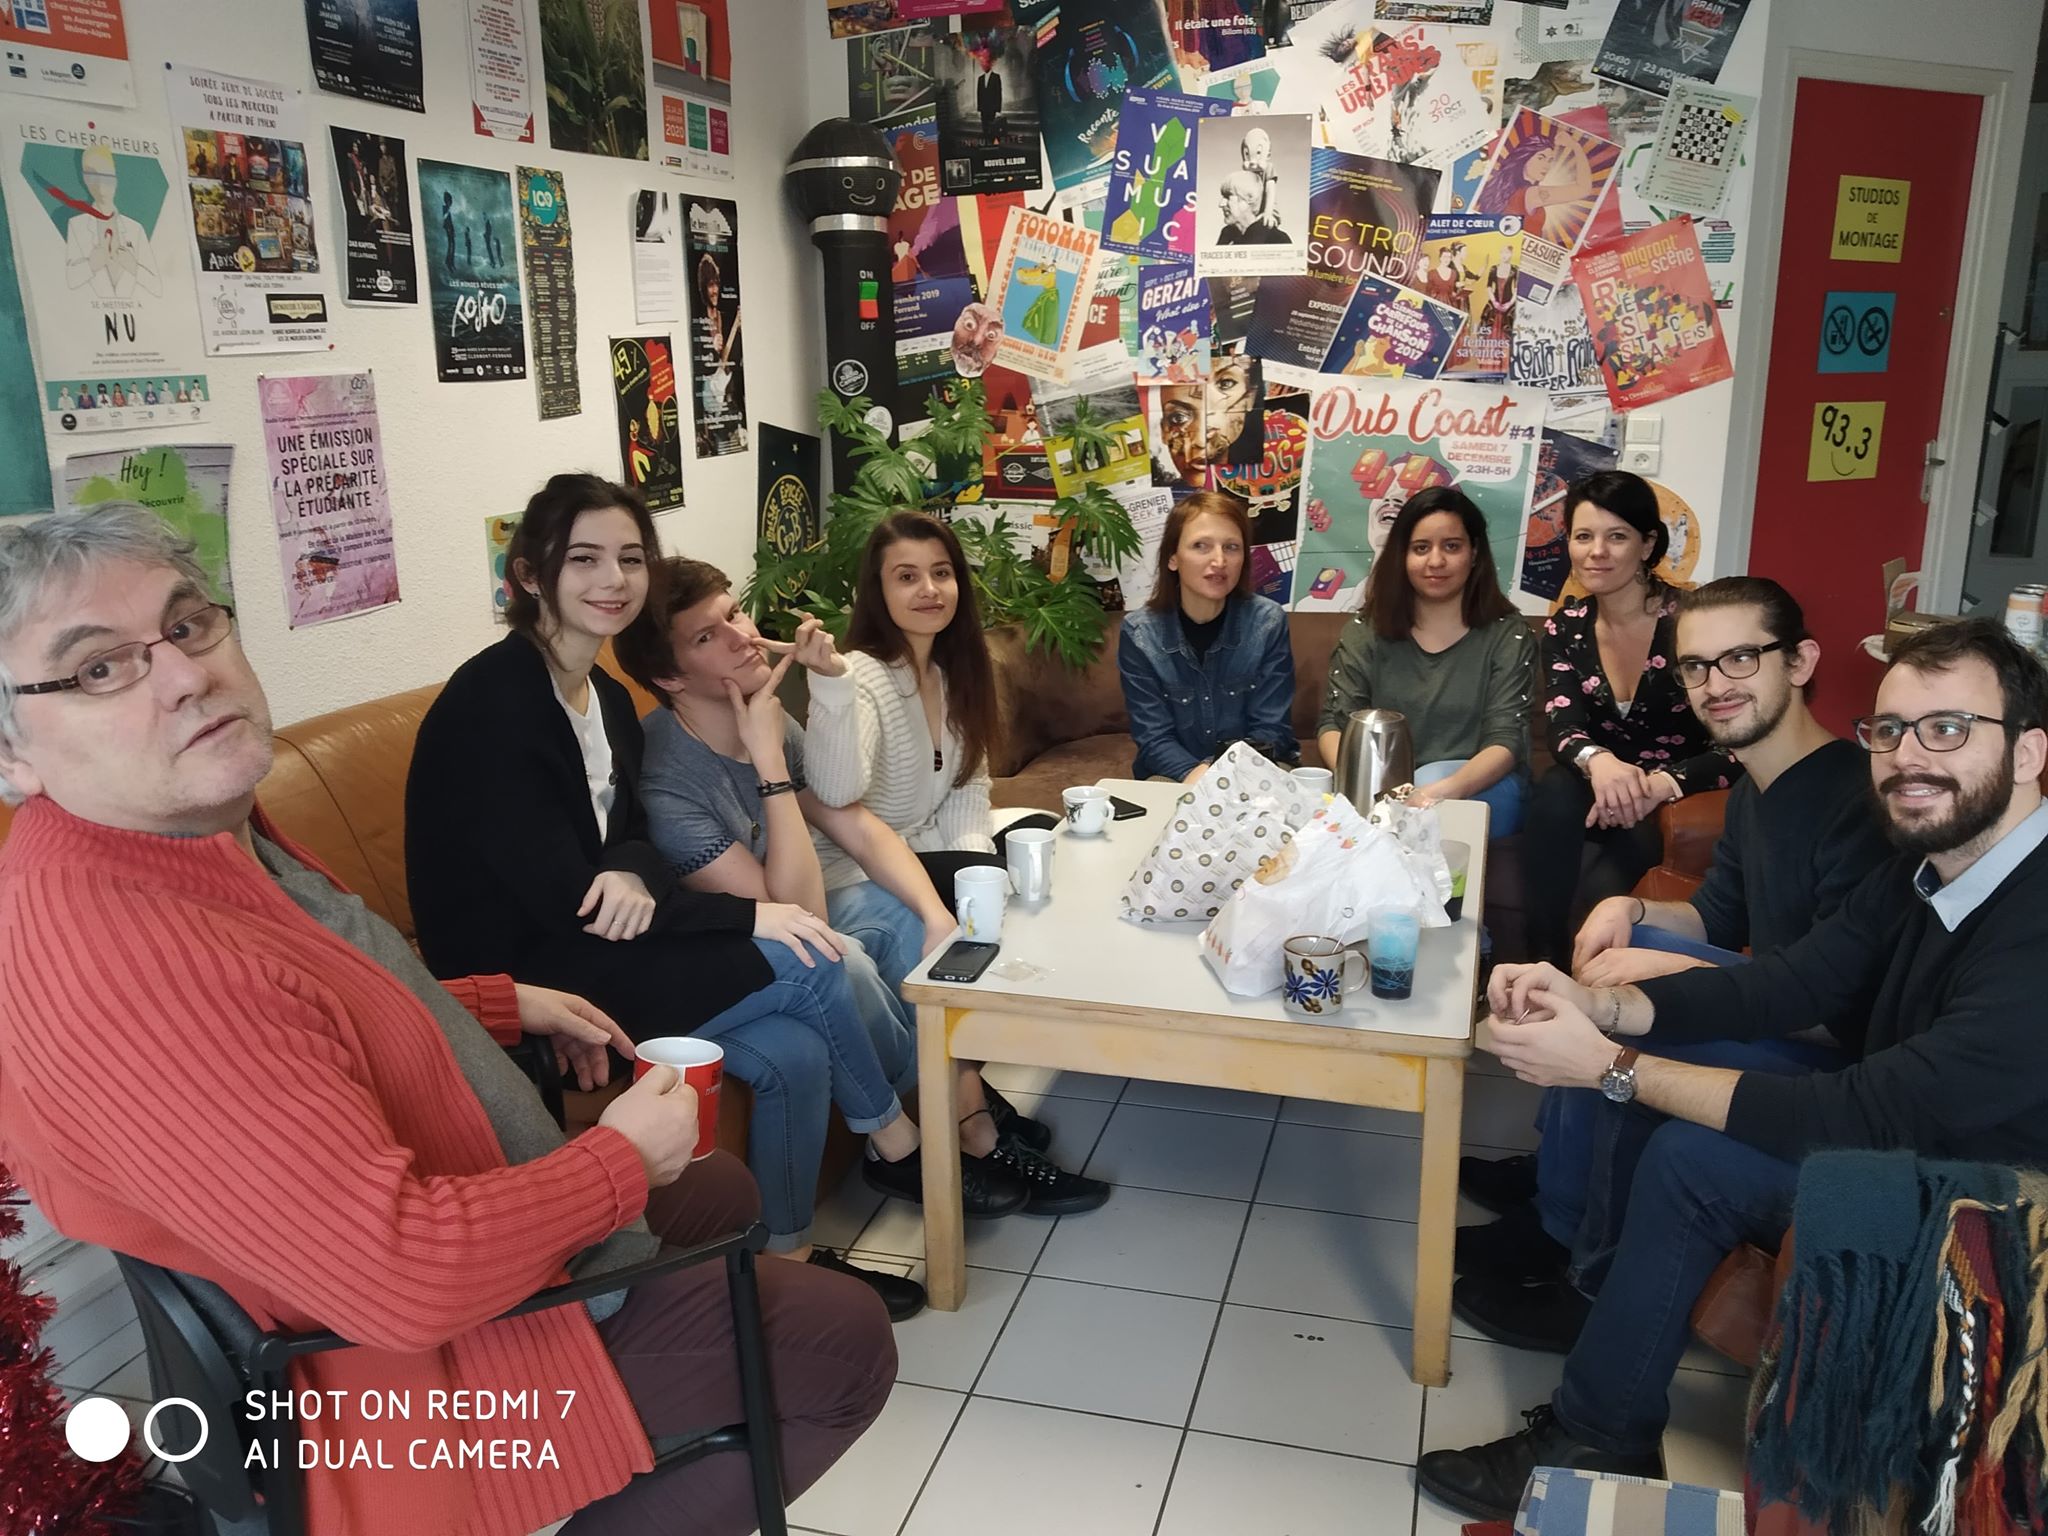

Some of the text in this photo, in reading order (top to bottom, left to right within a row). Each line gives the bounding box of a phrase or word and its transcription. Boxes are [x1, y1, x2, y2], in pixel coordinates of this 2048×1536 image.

[1184, 17, 1210, 30] était
[1211, 17, 1231, 27] une
[1335, 80, 1356, 97] LES
[1078, 107, 1121, 144] Raconte
[20, 124, 160, 155] LES CHERCHEURS
[1849, 187, 1900, 205] STUDIOS
[1452, 220, 1464, 228] DE
[1866, 212, 1879, 224] DE
[1307, 215, 1416, 255] ECTRO
[1839, 230, 1899, 249] MONTAGE
[1307, 241, 1407, 279] SOUND
[1621, 235, 1677, 268] migrant
[859, 270, 873, 279] ON
[921, 289, 940, 300] 2019
[1142, 277, 1202, 311] GERZAT
[1089, 304, 1109, 325] CE
[1376, 303, 1430, 332] CARREFOUR
[105, 312, 136, 345] NU
[860, 322, 876, 331] OFF
[1368, 315, 1430, 351] CHANSON
[1298, 343, 1321, 355] Entrée
[1395, 343, 1424, 361] 2017
[1463, 337, 1510, 349] femmes
[1456, 347, 1507, 360] savantes
[1311, 386, 1537, 445] Dub Coast #4
[277, 427, 373, 453] UNE ÉMISSION
[1821, 404, 1873, 461] 93.3
[1452, 441, 1508, 453] SAMEDI 7
[281, 449, 375, 476] SPÉCIALE SUR
[1448, 452, 1512, 465] DECEMBRE
[120, 456, 151, 491] Hey
[1466, 464, 1511, 476] 23H-5H
[284, 465, 378, 498] LA PRÉCARITÉ
[297, 491, 372, 518] ÉTUDIANTE
[1158, 505, 1171, 516] #6
